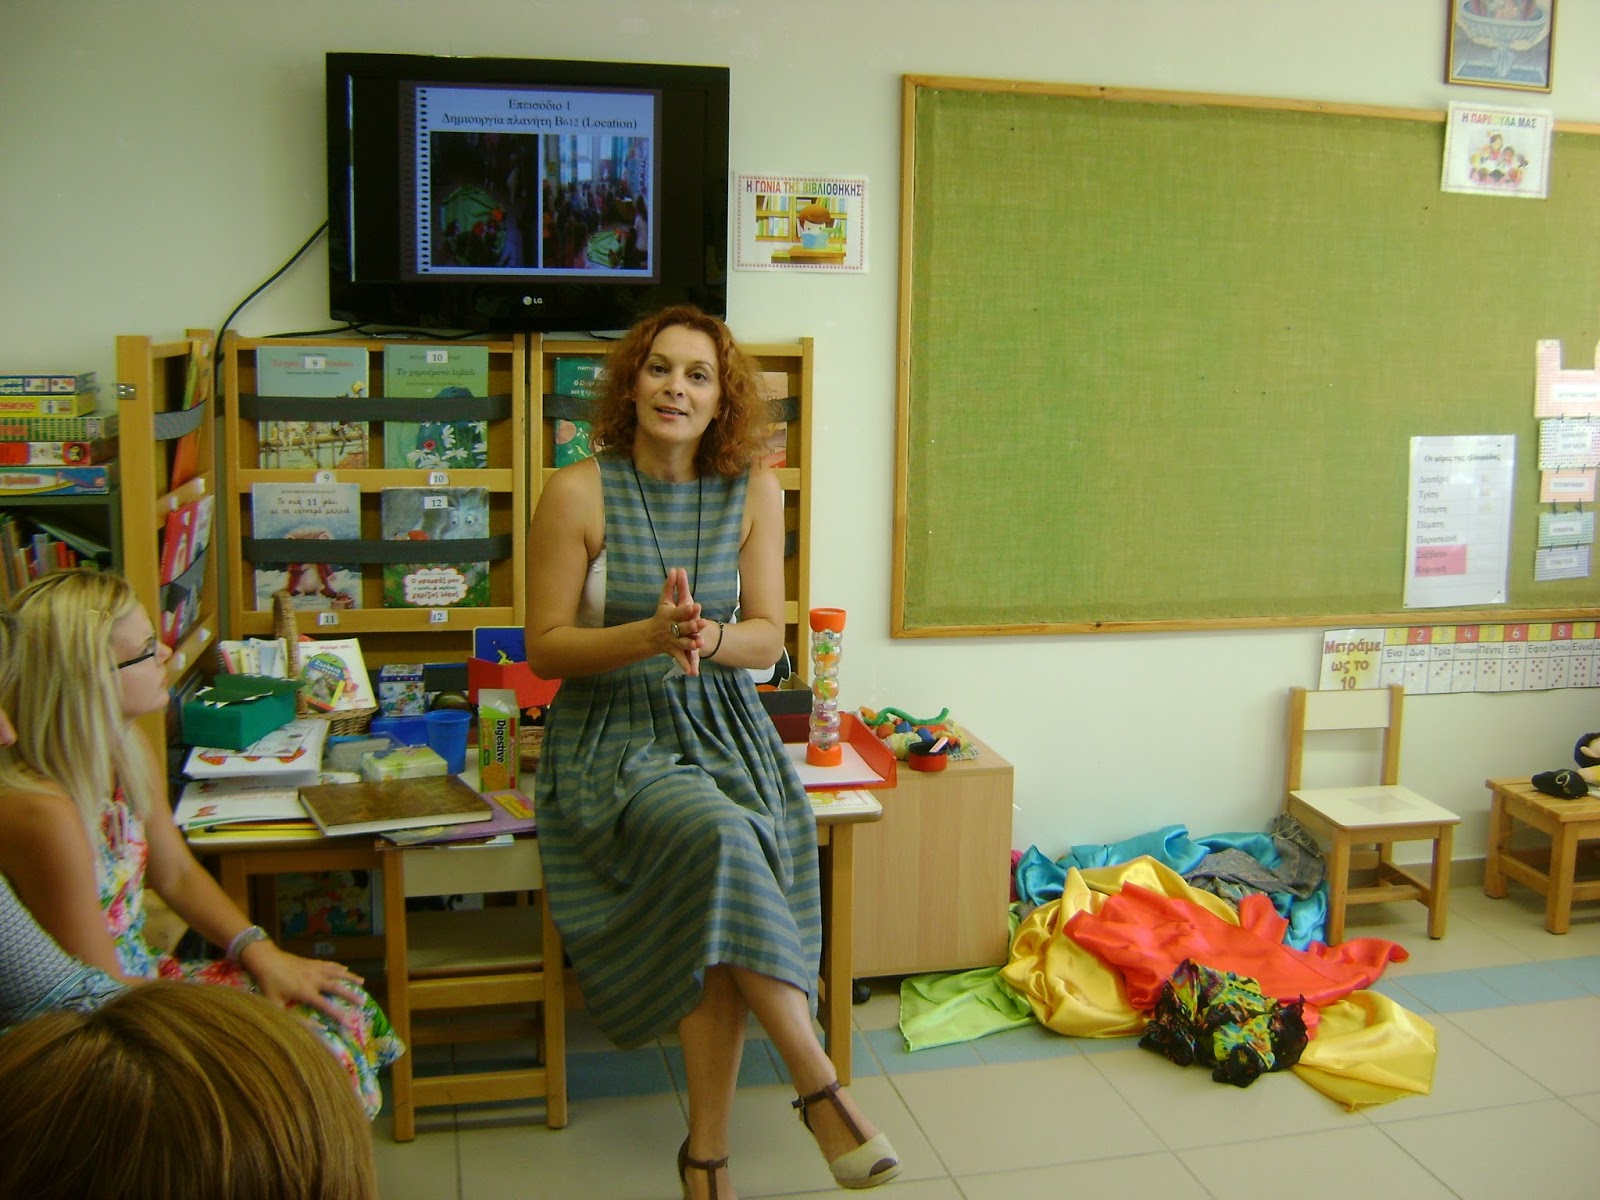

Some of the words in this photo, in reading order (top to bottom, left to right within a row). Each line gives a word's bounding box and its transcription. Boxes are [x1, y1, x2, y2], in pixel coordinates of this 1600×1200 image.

[441, 113, 505, 127] Δημιουργία
[506, 115, 552, 128] πλανήτη
[582, 117, 638, 129] (Location)
[1518, 117, 1537, 129] ΜΑΣ
[746, 180, 753, 192] Η
[755, 180, 781, 193] ΓΩΝΙΑ
[783, 182, 800, 194] ΤΗΣ
[802, 182, 861, 196] ΒΙΒΛΙΟΘΗΚΗΣ
[432, 353, 443, 362] 10
[434, 474, 444, 483] 10
[307, 498, 317, 506] 11
[432, 499, 442, 507] 12
[325, 615, 335, 624] 11
[433, 612, 443, 621] 12
[1416, 629, 1425, 642] 2
[1464, 629, 1472, 640] 4
[1512, 627, 1520, 639] 6
[1557, 625, 1566, 638] 8
[1324, 638, 1382, 655] Μετράμε
[1331, 661, 1350, 674] ως
[1354, 660, 1369, 670] το
[1340, 676, 1356, 689] 10
[495, 720, 506, 763] Digestive
